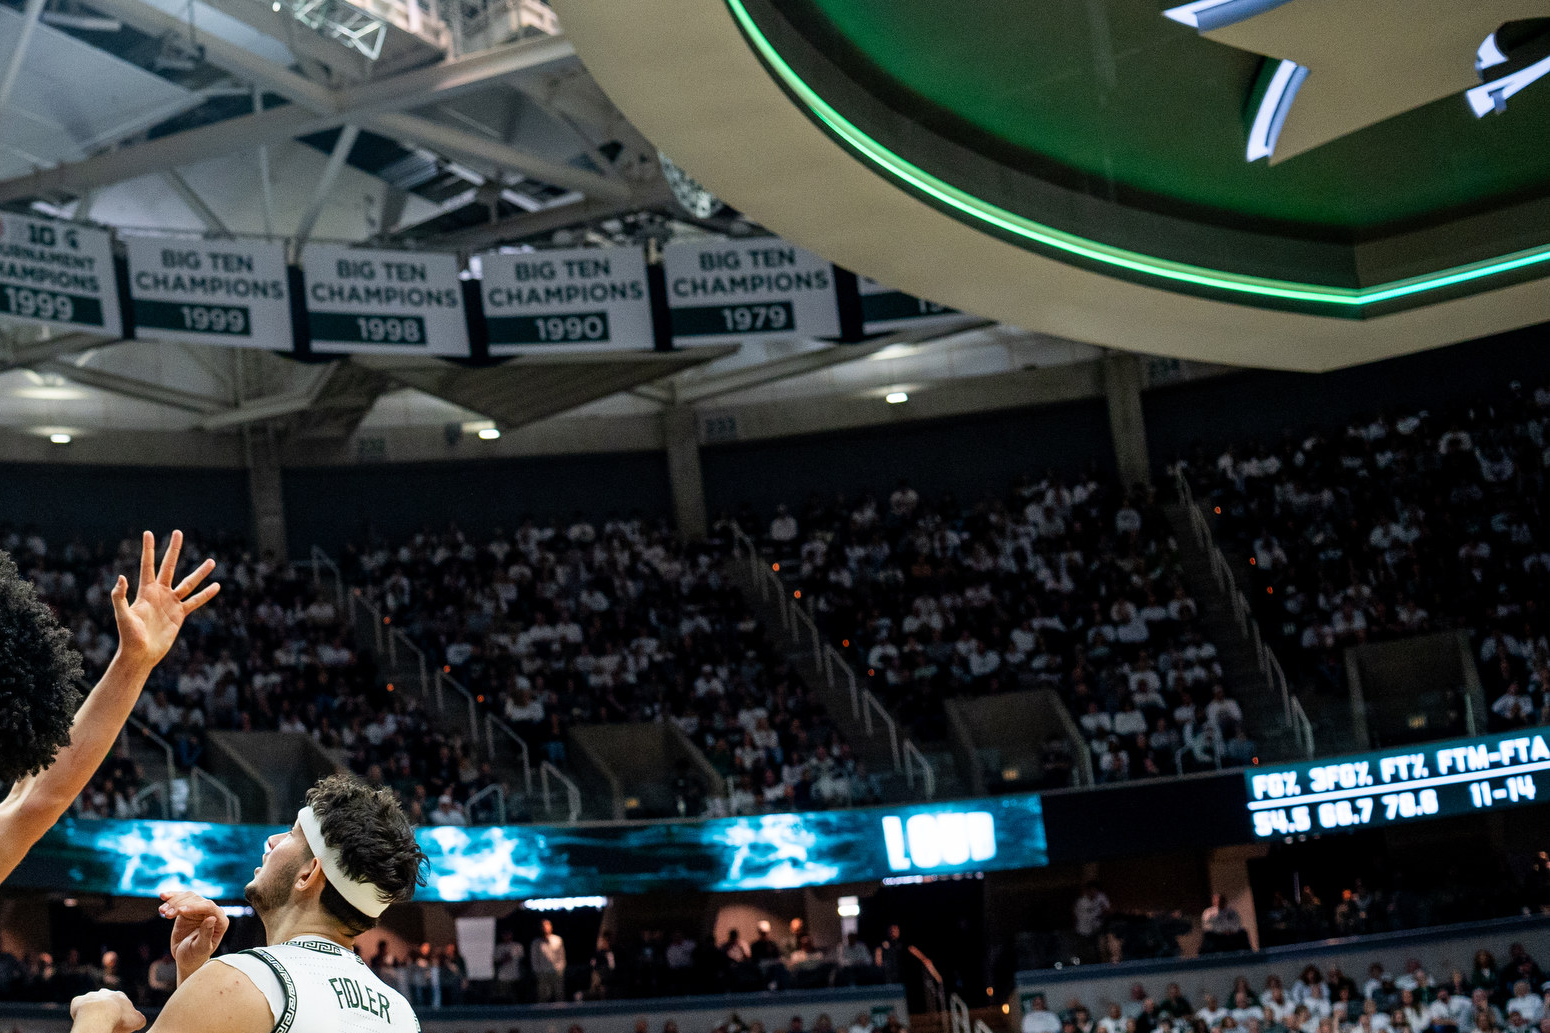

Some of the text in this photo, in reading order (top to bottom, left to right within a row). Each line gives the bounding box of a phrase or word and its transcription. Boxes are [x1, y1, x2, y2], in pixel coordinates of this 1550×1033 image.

[160, 247, 254, 274] BIG TEN
[336, 258, 427, 283] BIG TEN
[514, 256, 611, 282] BIG TEN
[697, 245, 797, 272] BIG TEN
[134, 270, 285, 300] CHAMPIONS
[310, 281, 459, 310] CHAMPIONS
[487, 279, 645, 308] CHAMPIONS
[671, 269, 831, 299] CHAMPIONS
[3, 285, 74, 322] 1999
[721, 304, 788, 331] 1979
[180, 305, 246, 333] 1999
[356, 316, 422, 344] 1998
[534, 315, 604, 342] 1990
[1380, 753, 1429, 783] FT%
[1437, 735, 1550, 775] FTM-FTA
[1253, 806, 1311, 837] 54.5
[1470, 775, 1536, 808] 11-14
[328, 977, 391, 1024] FIDLER
